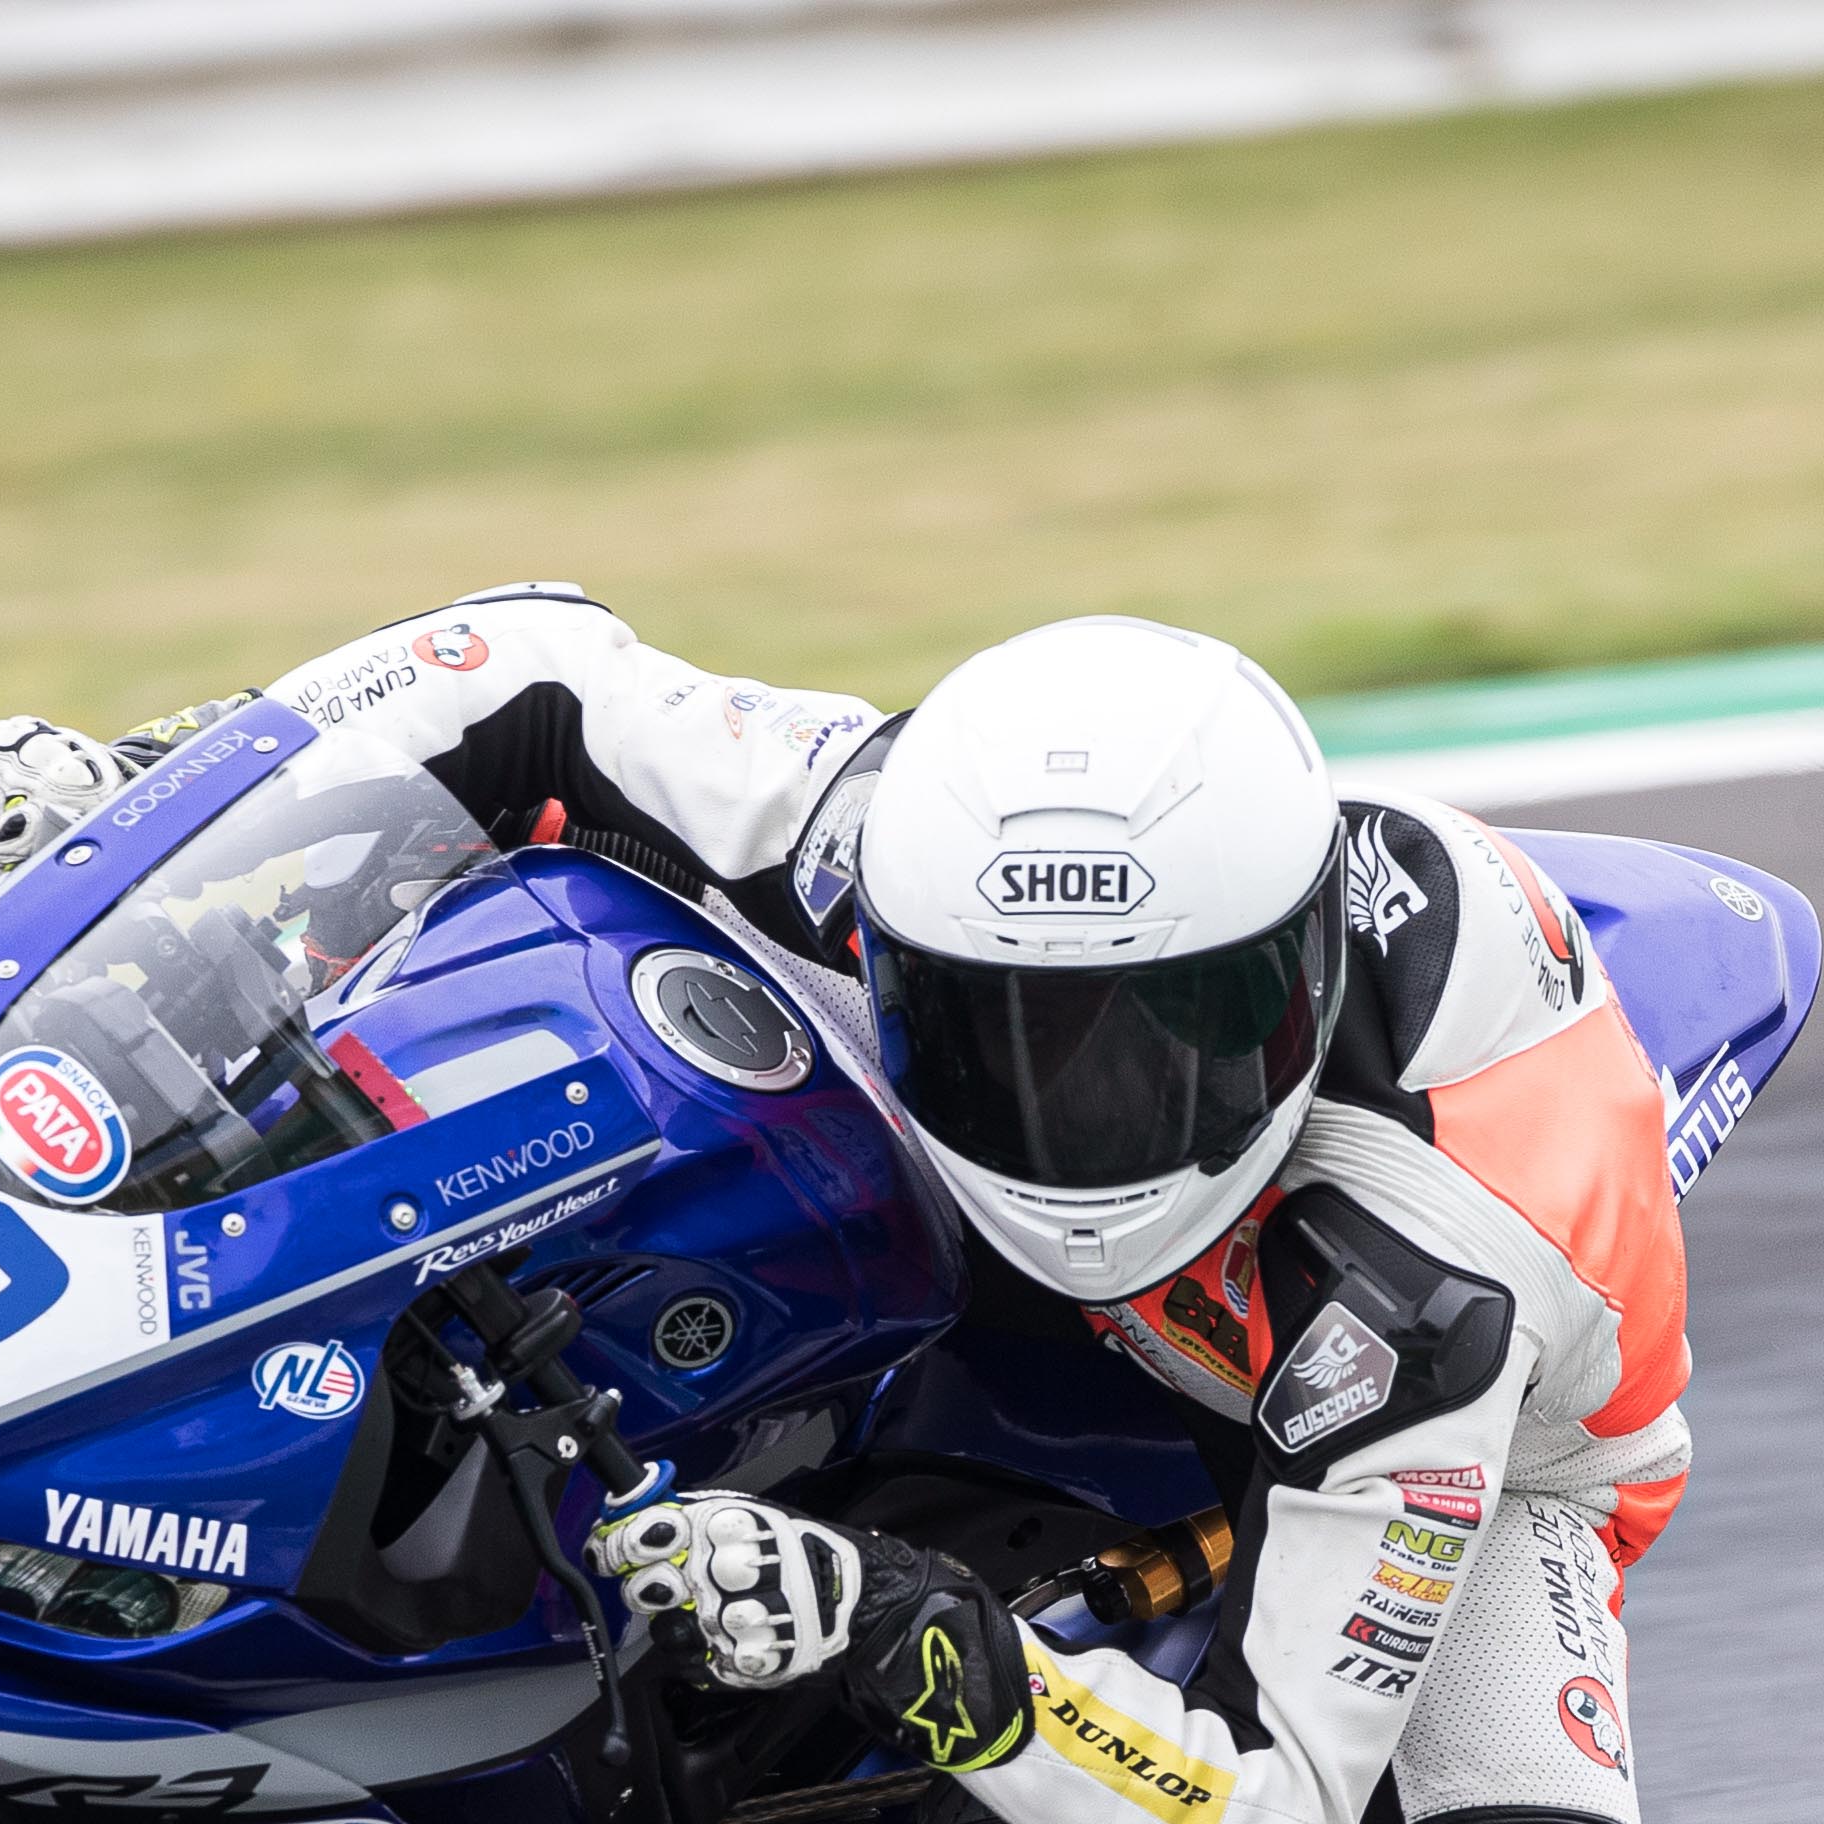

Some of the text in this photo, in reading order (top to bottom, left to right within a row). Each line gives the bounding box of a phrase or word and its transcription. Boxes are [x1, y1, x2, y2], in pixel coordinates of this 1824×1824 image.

[112, 730, 254, 827] KENWOOD
[1001, 863, 1128, 903] SHOEI
[1537, 955, 1565, 1012] CUNA
[2, 1072, 91, 1168] PATA
[57, 1060, 112, 1120] SNACK
[435, 1121, 595, 1207] KENWOOD
[1667, 1058, 1753, 1207] OTUS
[133, 1226, 158, 1336] KENWOOD
[174, 1230, 212, 1311] JVC
[1283, 1376, 1380, 1446] GIUSEPPE
[1395, 1467, 1483, 1489] MOTUL
[1432, 1496, 1476, 1514] SHIRO
[45, 1488, 248, 1577] YAMAHA
[1379, 1540, 1426, 1566] Brake
[1383, 1519, 1466, 1563] NG
[1525, 1500, 1587, 1661] CUNA DE
[1048, 1698, 1212, 1807] DUNLOP
